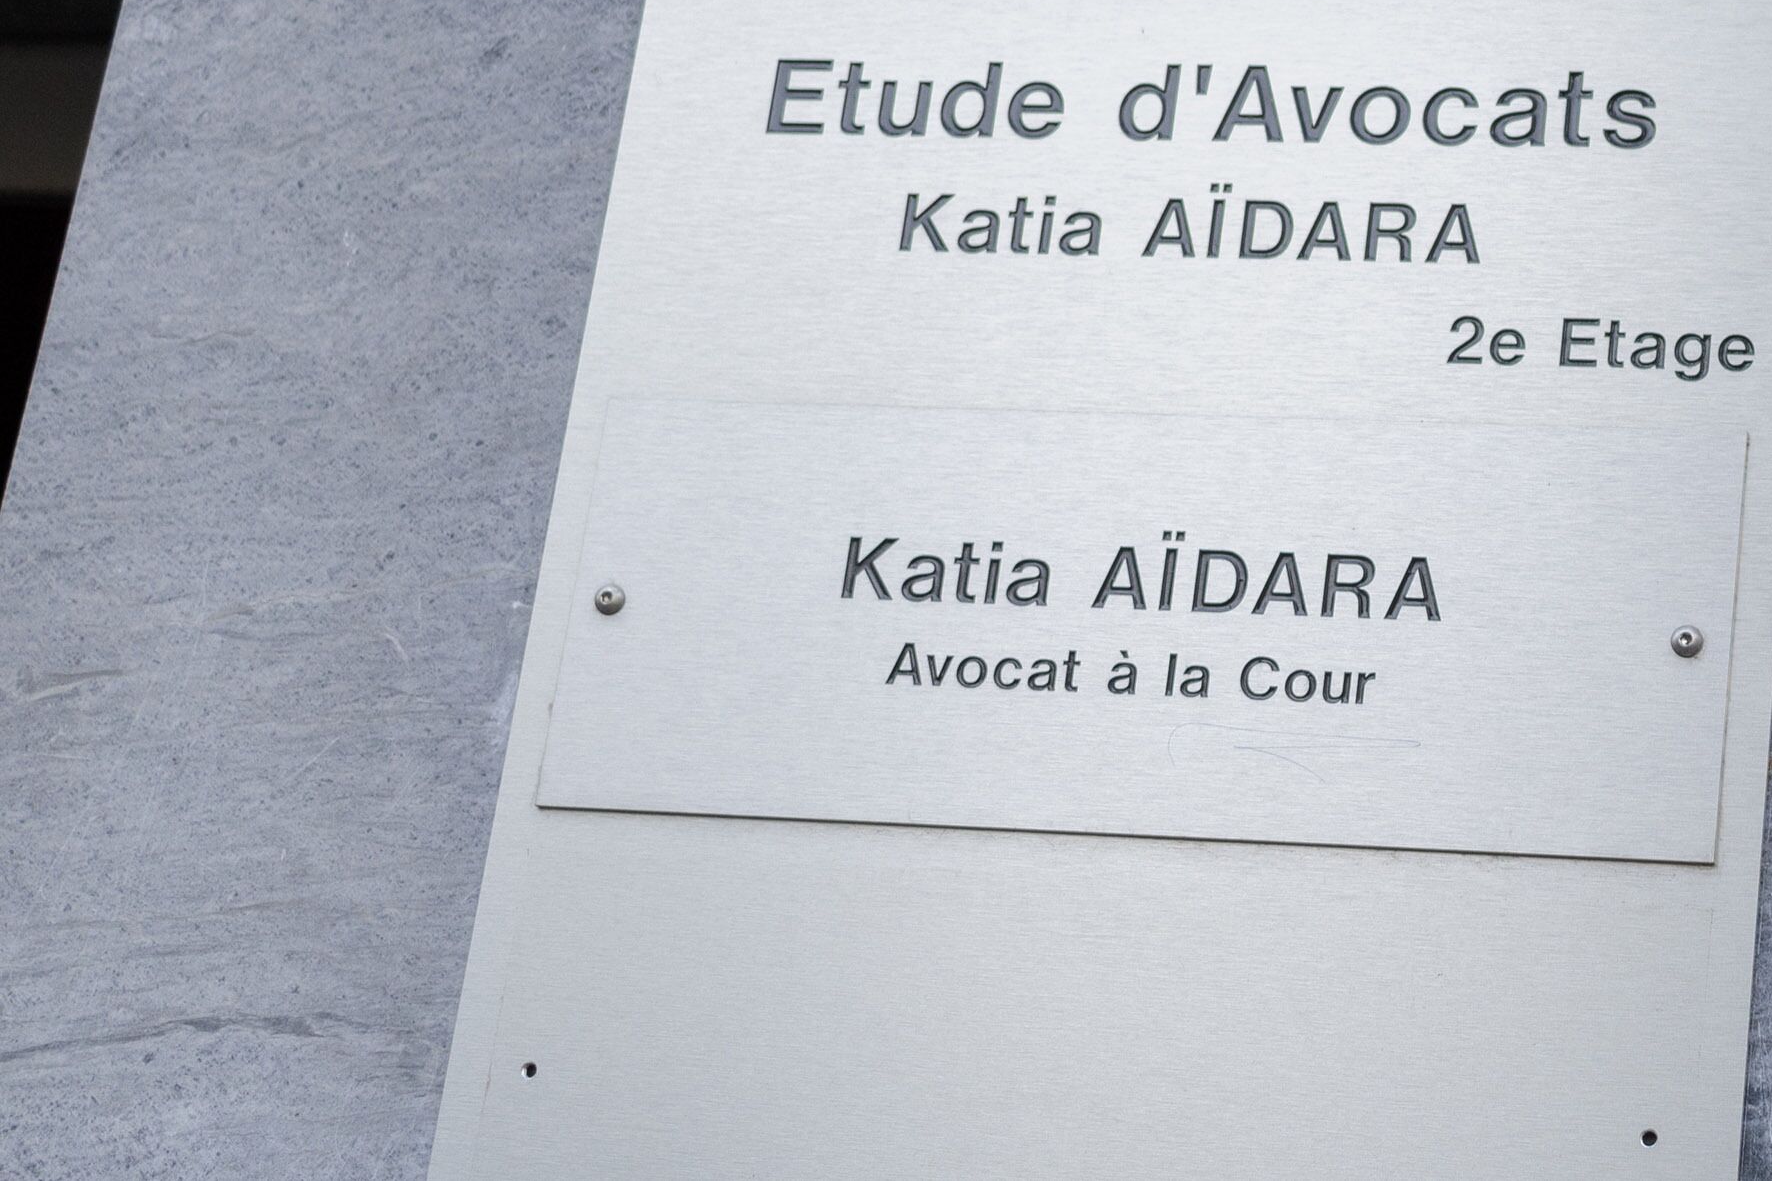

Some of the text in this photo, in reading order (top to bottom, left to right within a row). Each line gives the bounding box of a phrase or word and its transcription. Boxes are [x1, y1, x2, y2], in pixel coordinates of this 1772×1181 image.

[764, 58, 1659, 151] Etude d'Avocats
[897, 183, 1482, 264] Katia AÏDARA
[1446, 314, 1757, 382] 2e Etage
[839, 530, 1443, 623] Katia AÏDARA
[884, 641, 1378, 706] Avocat à la Cour
